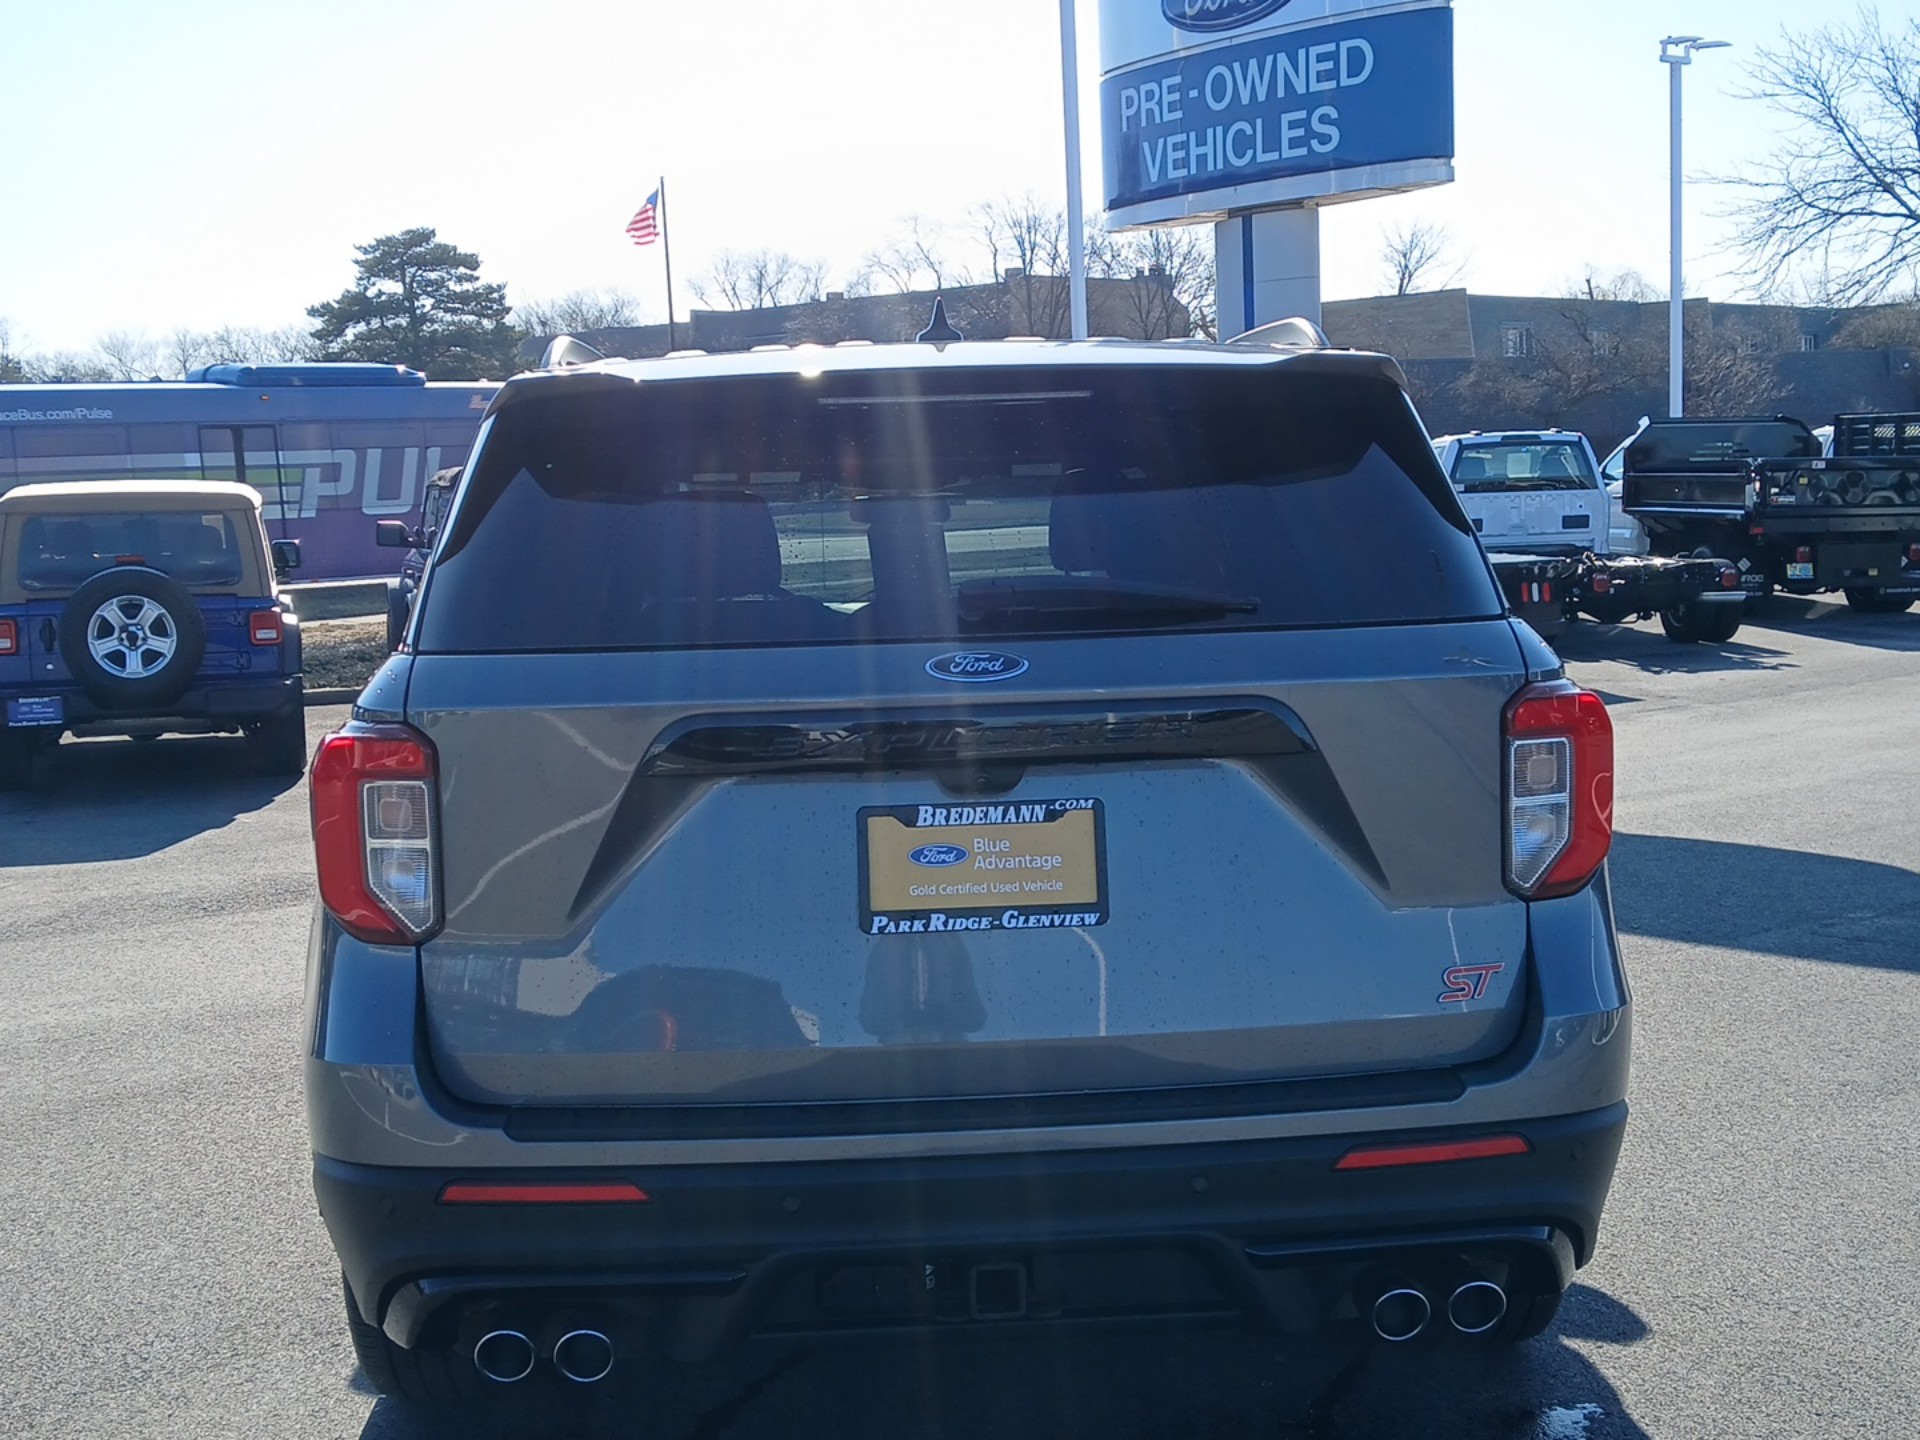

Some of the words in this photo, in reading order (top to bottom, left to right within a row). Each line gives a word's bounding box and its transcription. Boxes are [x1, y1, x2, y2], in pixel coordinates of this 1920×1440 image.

[1142, 105, 1342, 183] VEHICLES
[950, 654, 1005, 673] Ford
[916, 804, 1048, 827] BREDEMANN
[920, 847, 957, 864] Ford
[973, 838, 1010, 854] Blue
[974, 853, 1062, 870] Advantage
[909, 883, 936, 896] Gold
[939, 882, 988, 895] Certified
[990, 881, 1019, 894] Used
[1022, 879, 1064, 892] Vehicle
[870, 915, 927, 934] PARK
[928, 909, 1100, 932] RIDGE-GLENVIEW
[1439, 962, 1505, 1003] ST
